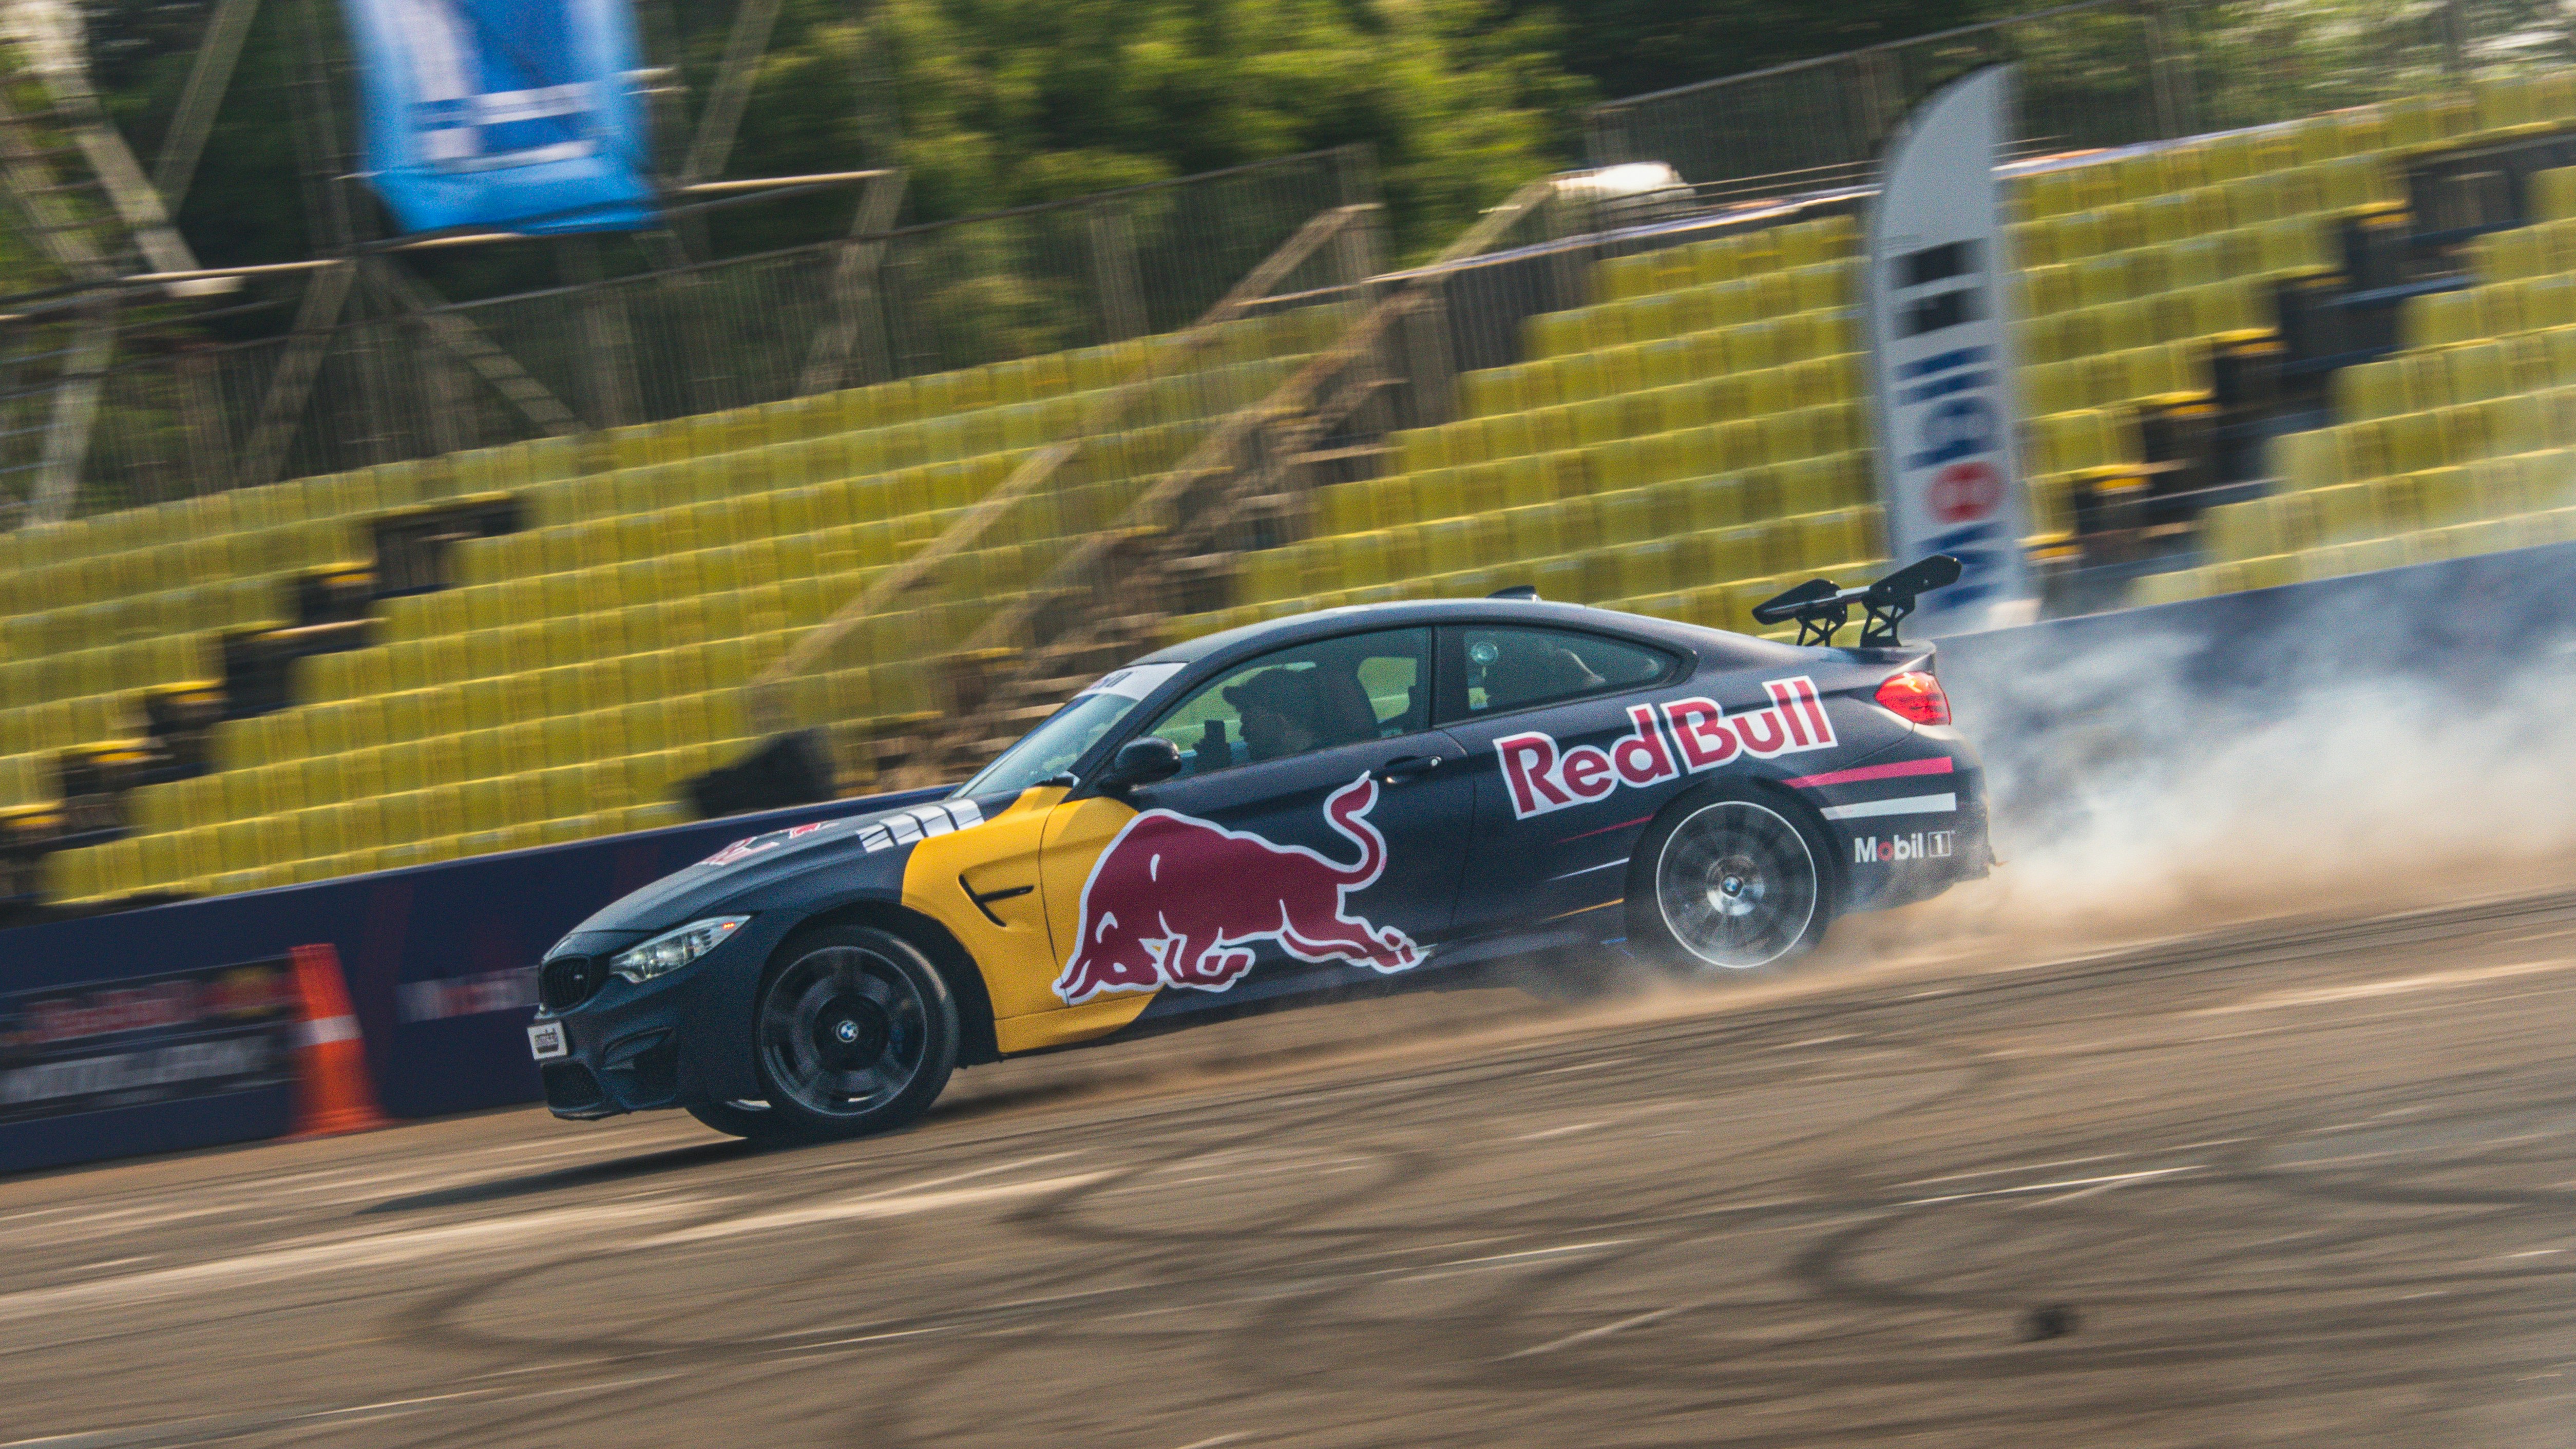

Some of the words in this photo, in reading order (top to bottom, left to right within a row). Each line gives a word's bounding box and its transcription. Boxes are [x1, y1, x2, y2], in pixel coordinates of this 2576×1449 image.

[1496, 706, 1677, 817] Red
[1666, 677, 1835, 772] Bull
[1854, 832, 1924, 864] Mobil
